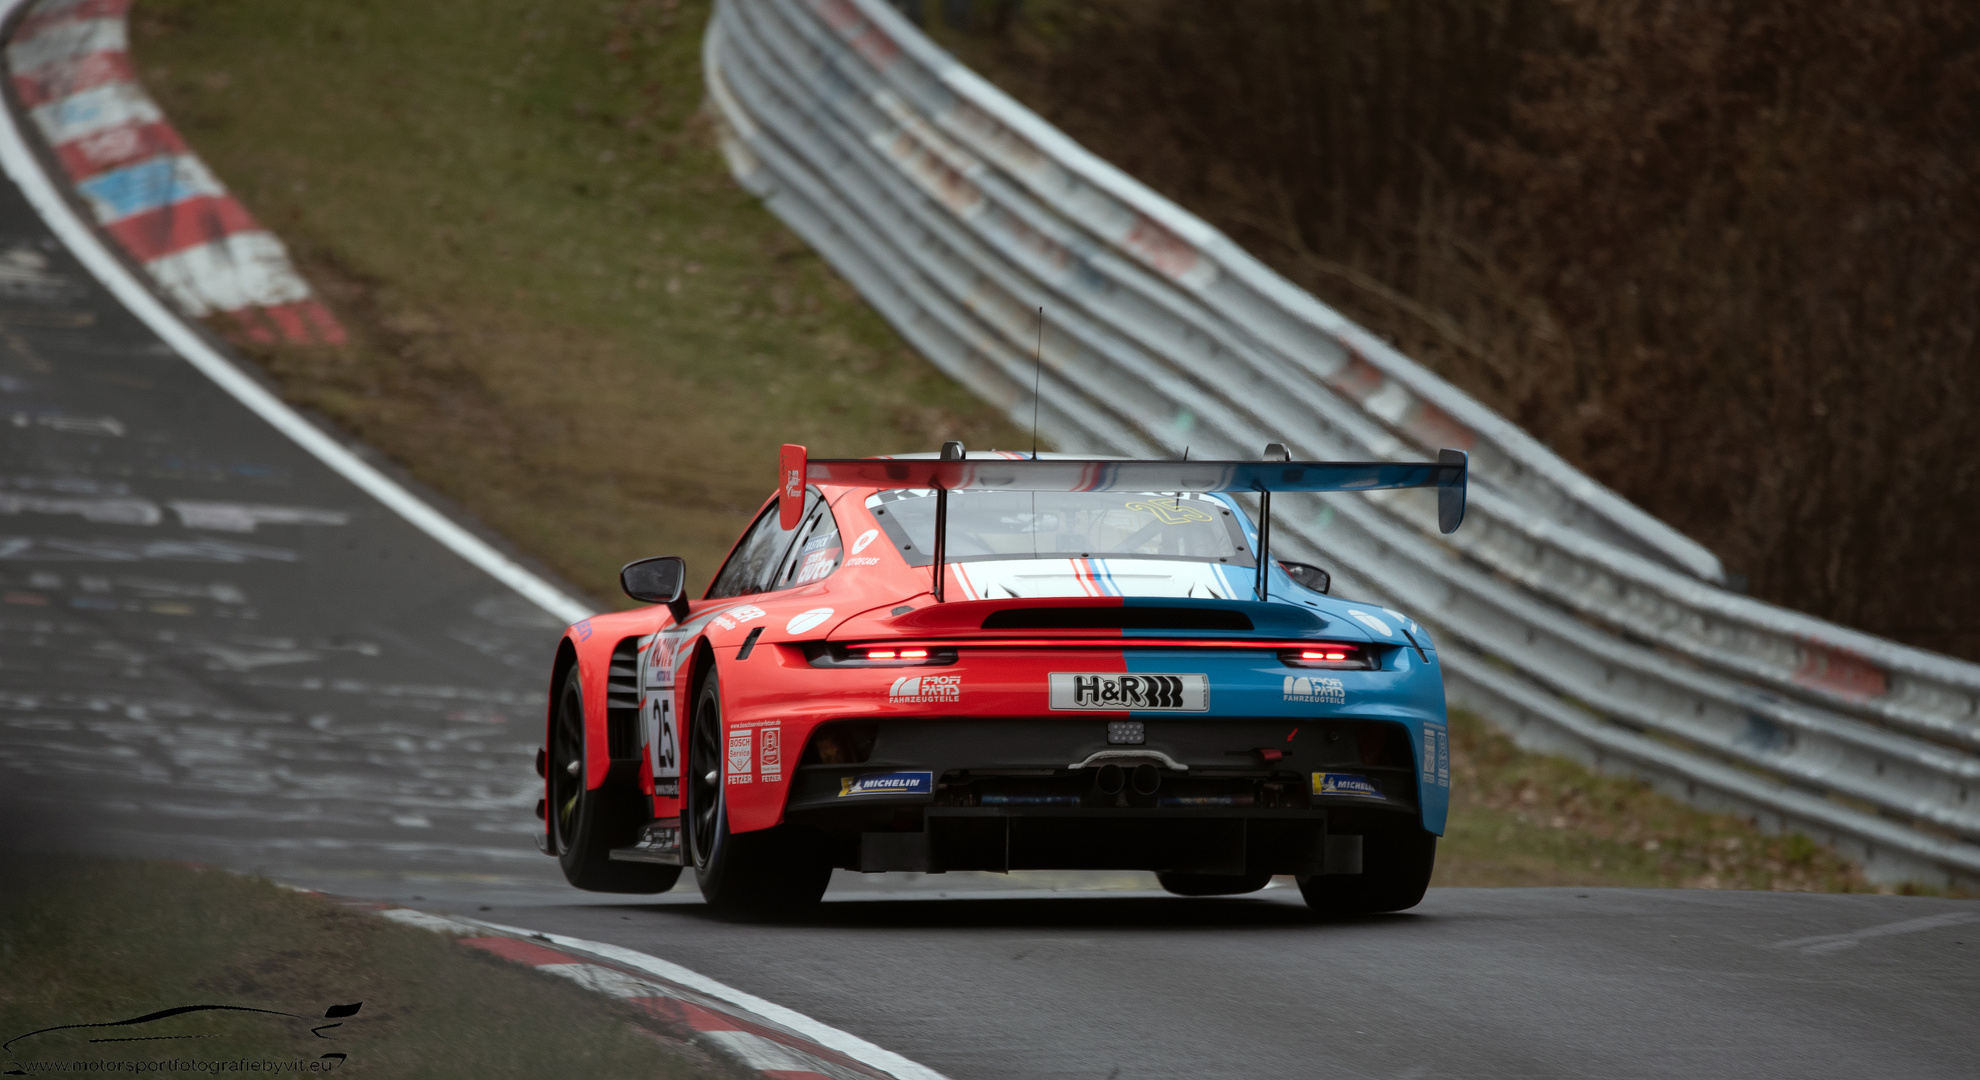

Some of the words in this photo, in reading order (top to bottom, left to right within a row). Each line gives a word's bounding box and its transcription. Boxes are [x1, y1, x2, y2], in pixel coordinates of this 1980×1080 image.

[1125, 498, 1213, 525] 25
[796, 558, 835, 584] auto
[922, 675, 961, 685] PROFI
[921, 684, 960, 696] PARTS
[1074, 675, 1147, 708] H&R
[889, 695, 960, 704] FAHRZEUGTEILE
[1283, 694, 1346, 705] FAHRZEUGTEILE
[653, 698, 675, 769] 25
[729, 738, 751, 748] BOSCH
[729, 750, 750, 758] Service
[728, 774, 753, 785] FETZER
[761, 774, 782, 783] FETZER
[863, 779, 920, 788] MICHELIN
